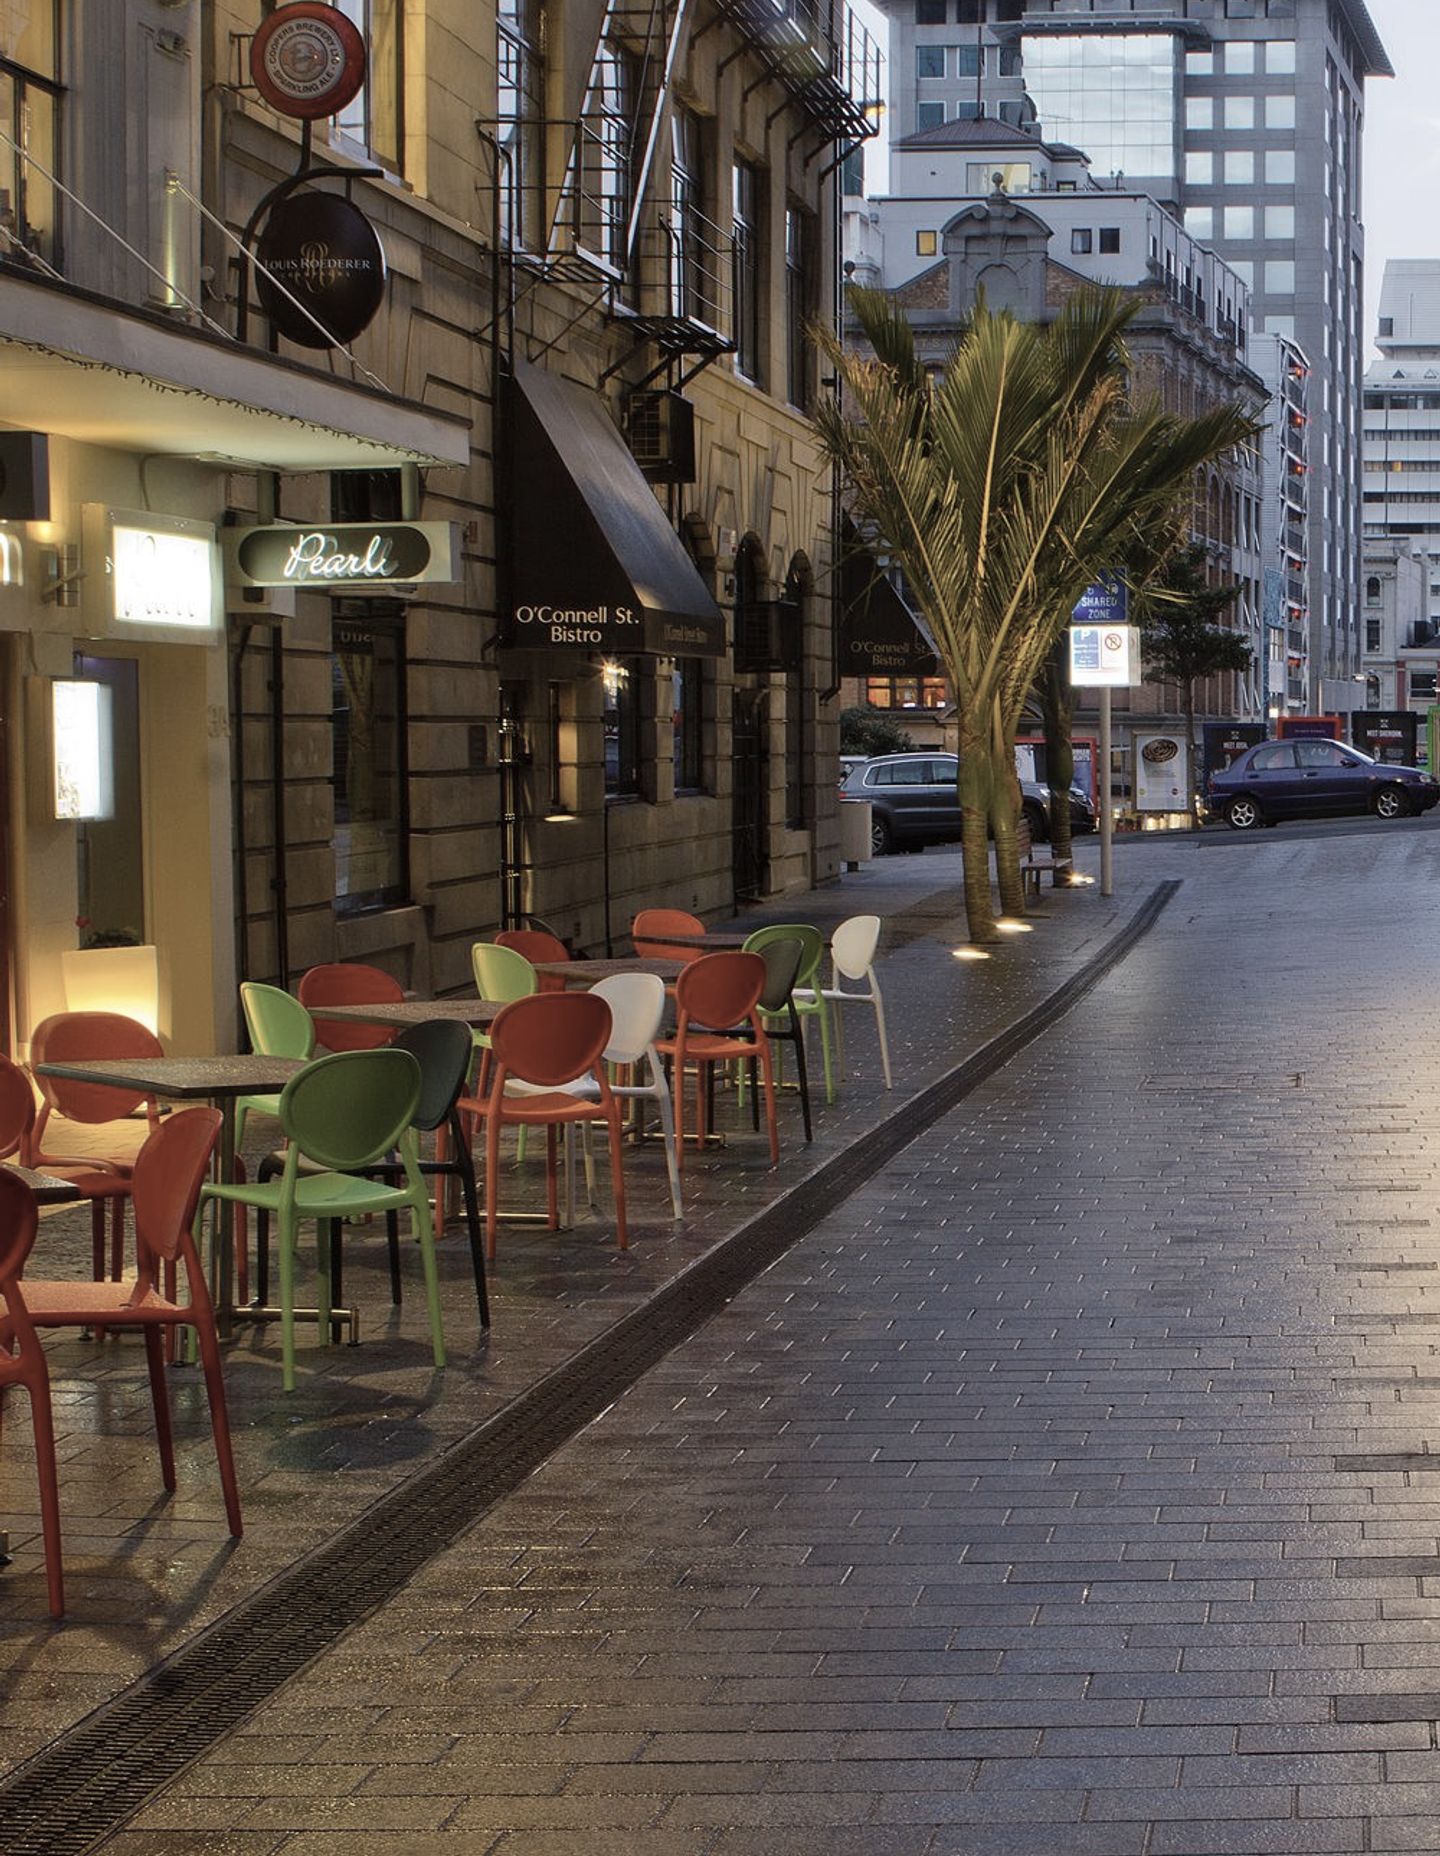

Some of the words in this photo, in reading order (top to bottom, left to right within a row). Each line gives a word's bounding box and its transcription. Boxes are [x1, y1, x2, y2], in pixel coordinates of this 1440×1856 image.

[269, 26, 295, 64] COOPERS
[295, 23, 335, 46] BREWERY
[273, 69, 320, 93] SPARKLING
[320, 73, 334, 87] ALE
[300, 258, 371, 270] ROEDERER
[284, 532, 388, 577] Pearl
[1081, 596, 1117, 608] SHARED
[516, 605, 608, 624] O'Connell
[615, 606, 640, 625] St.
[1088, 608, 1112, 619] ZONE
[551, 626, 602, 643] Bistro
[850, 640, 910, 654] O'Connell
[872, 654, 906, 666] Bistro
